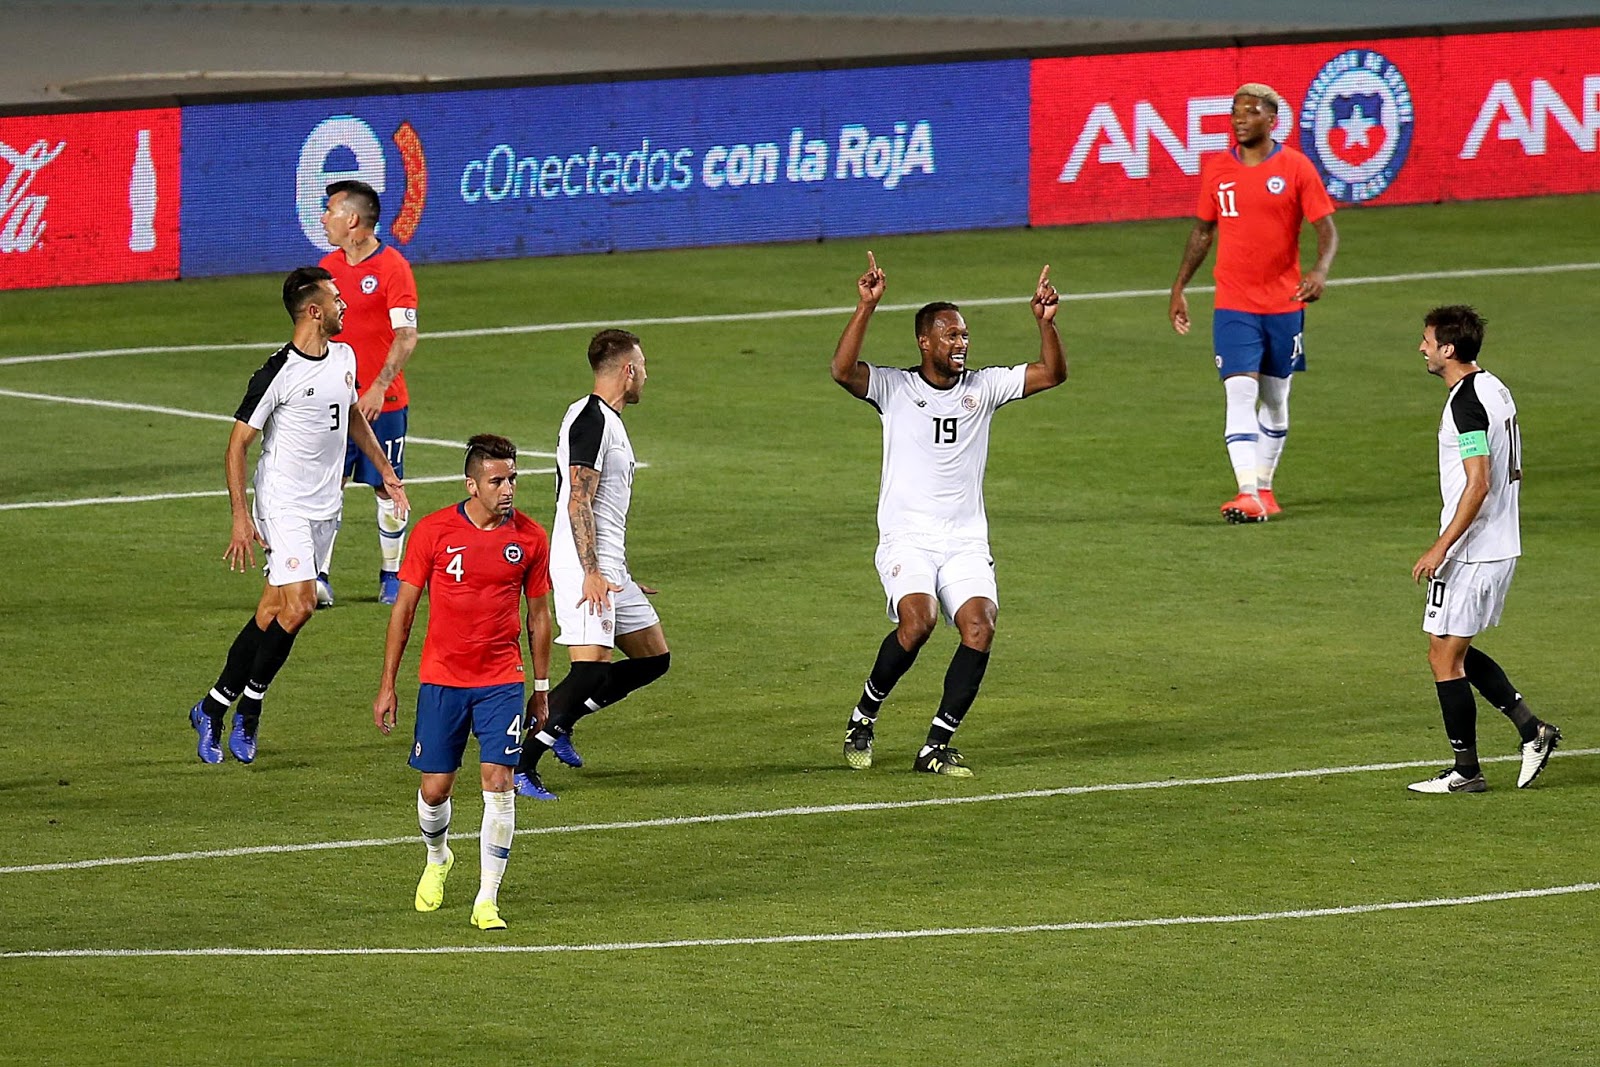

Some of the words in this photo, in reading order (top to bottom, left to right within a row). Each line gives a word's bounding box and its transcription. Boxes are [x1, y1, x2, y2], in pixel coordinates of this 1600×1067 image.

[460, 137, 694, 203] cOnectados
[702, 142, 780, 189] con
[786, 127, 828, 183] la
[835, 119, 936, 190] RojA
[1217, 190, 1239, 217] 11
[329, 403, 340, 431] 3
[932, 417, 958, 444] 19
[385, 437, 404, 464] 17
[446, 553, 465, 583] 4
[507, 714, 522, 744] 4
